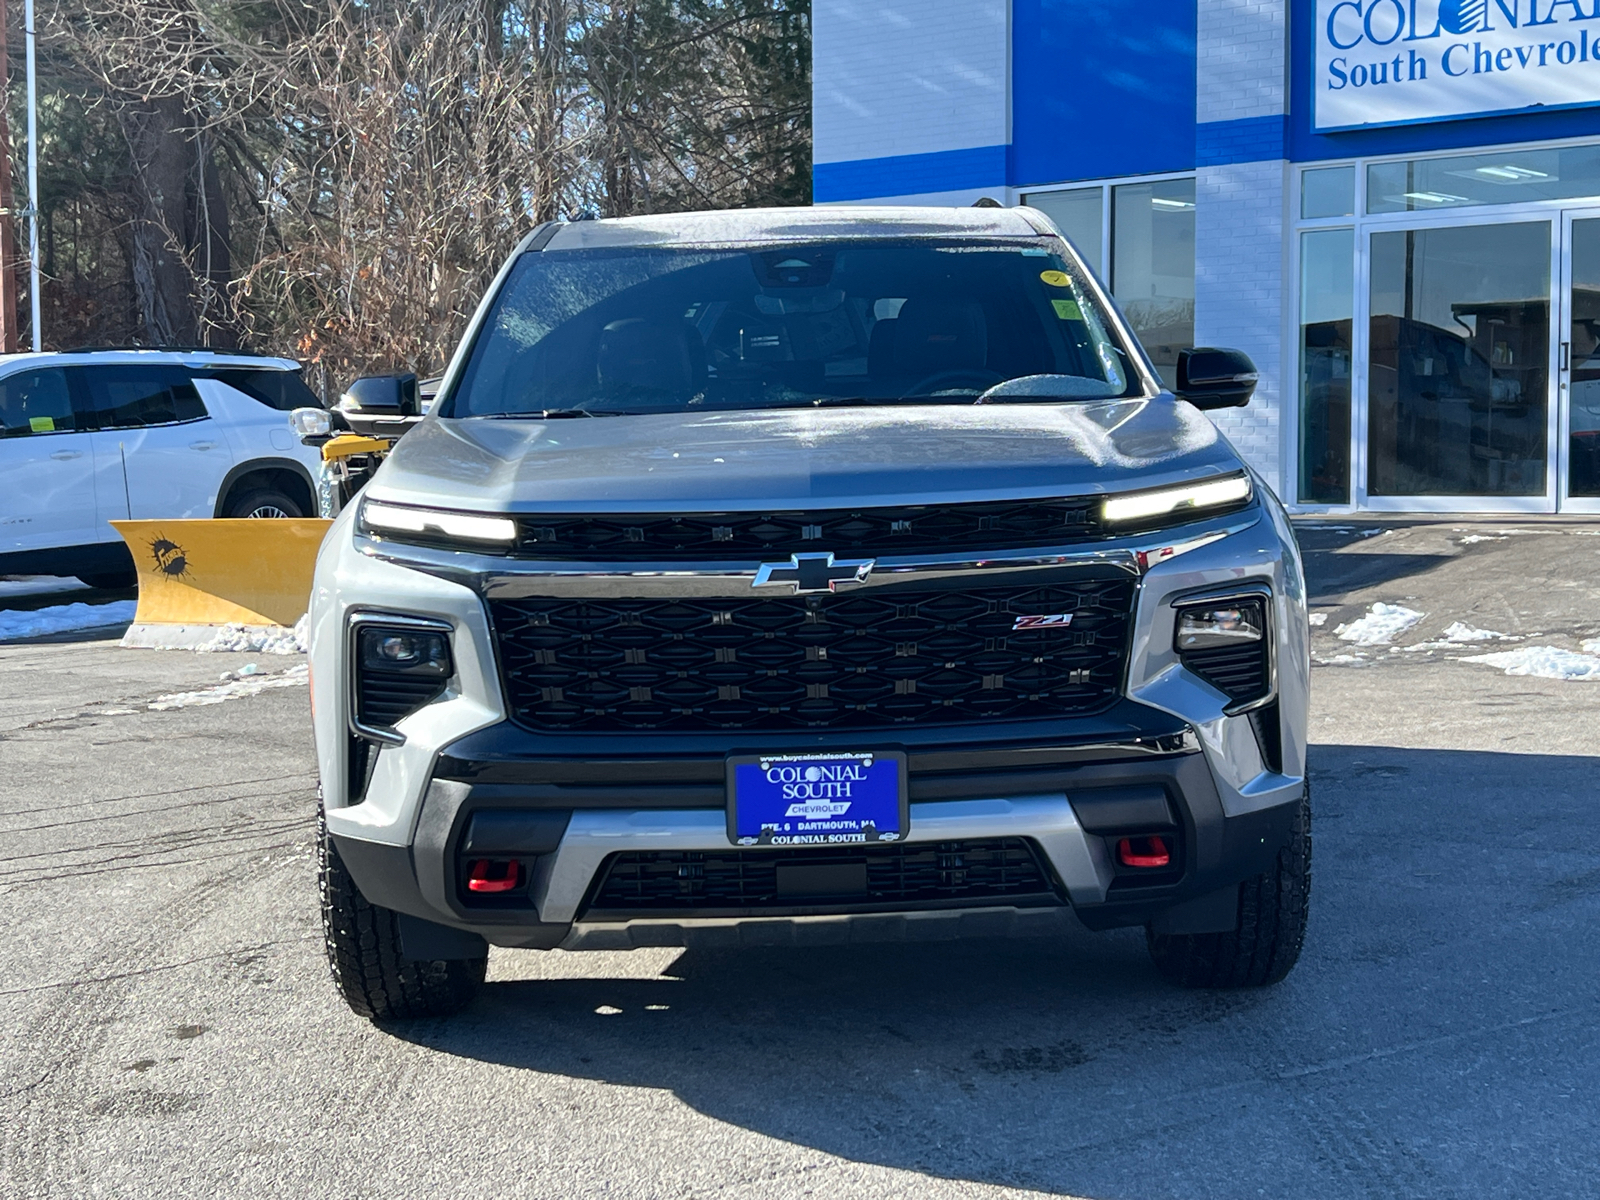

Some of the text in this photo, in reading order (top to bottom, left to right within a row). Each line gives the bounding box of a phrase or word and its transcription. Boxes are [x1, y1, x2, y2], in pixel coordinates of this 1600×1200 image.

[1328, 49, 1428, 91] South
[1012, 613, 1074, 630] Z71
[760, 752, 873, 763] www.buycolonialsouth.com
[766, 764, 868, 784] COLONIAL
[782, 781, 852, 799] SOUTH
[791, 804, 845, 814] CHEVROLET
[797, 820, 859, 831] DARTMOUTH,
[771, 833, 867, 845] COLONIAL SOUTH
